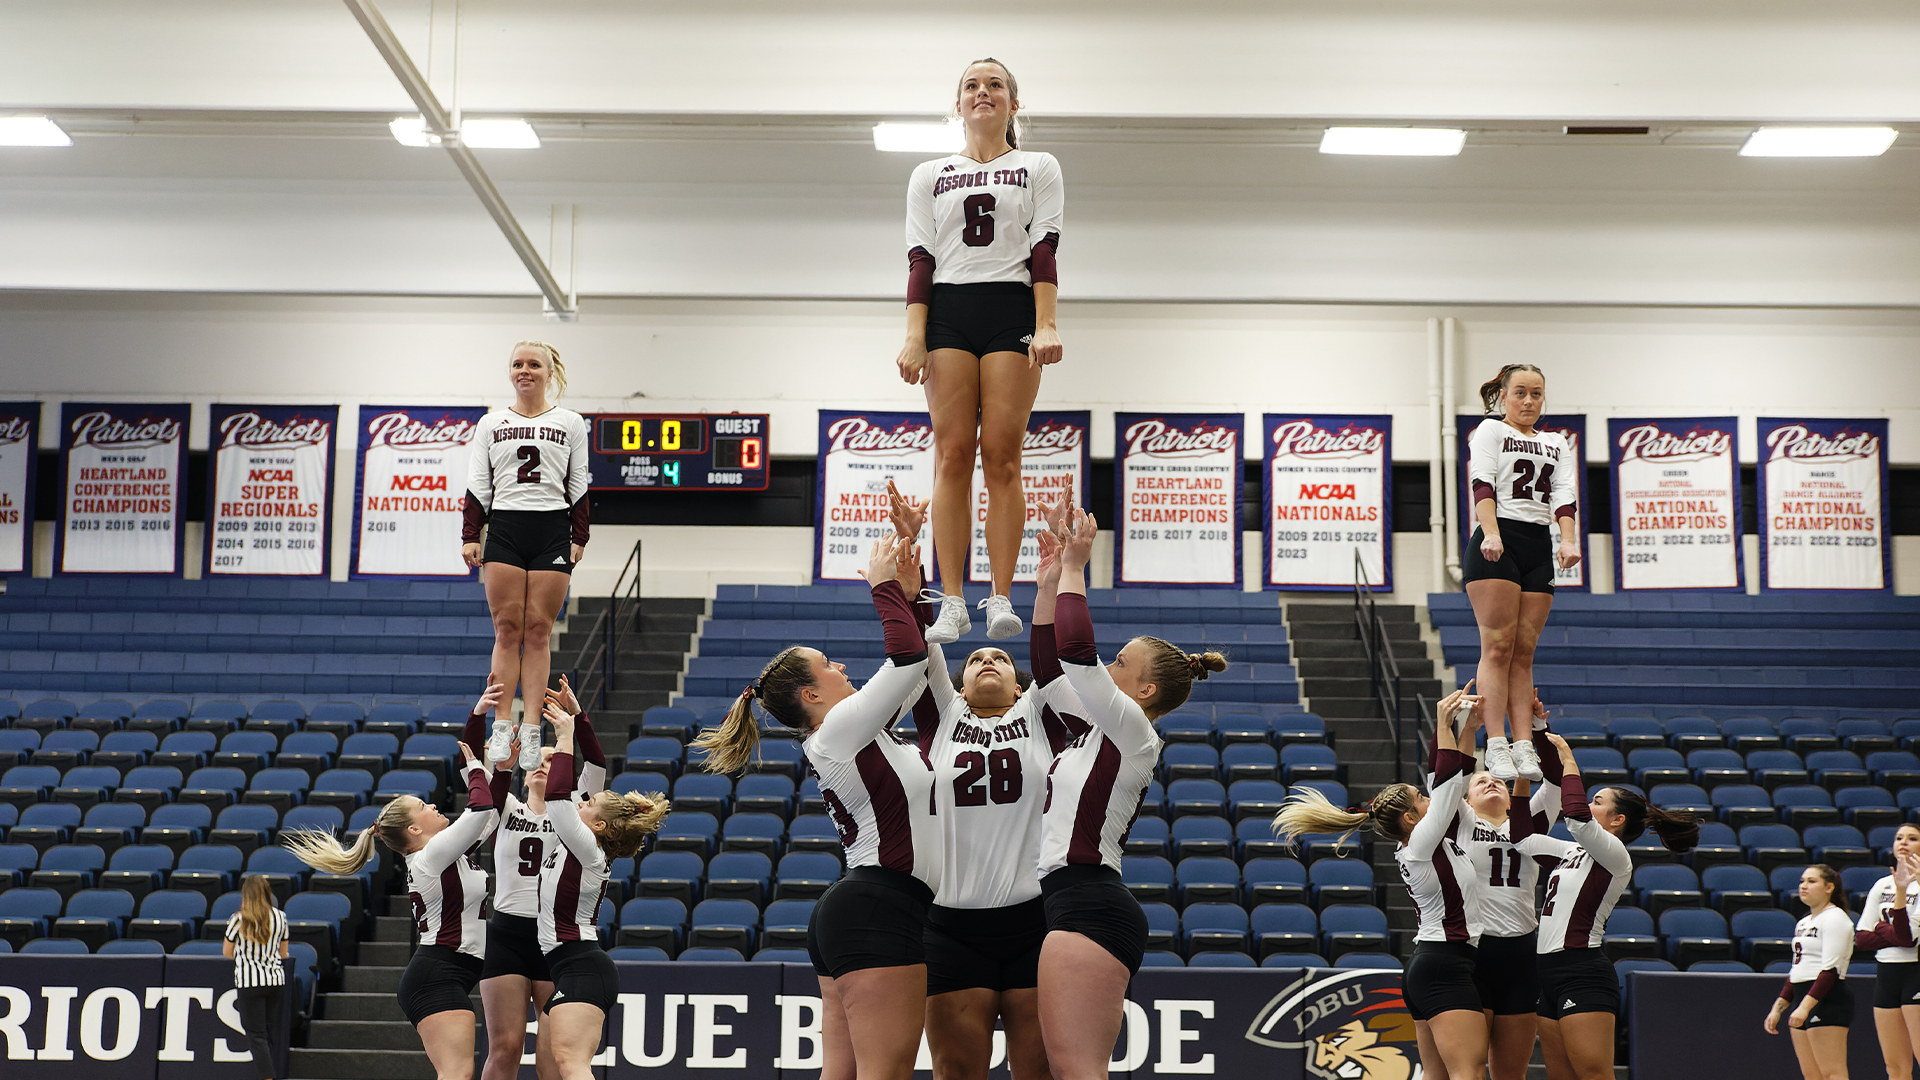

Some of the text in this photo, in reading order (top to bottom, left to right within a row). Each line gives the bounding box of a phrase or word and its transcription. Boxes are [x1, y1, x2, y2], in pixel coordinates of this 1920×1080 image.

[962, 193, 996, 247] 6
[71, 411, 181, 448] Patriots
[219, 411, 329, 448] Patriots
[368, 412, 477, 448] Patriots
[715, 418, 760, 434] GUEST
[493, 427, 566, 446] MISSOURI STATE
[827, 417, 935, 453] Patriots
[1125, 420, 1236, 456] Patriots
[1273, 420, 1384, 457] Patriots
[1619, 425, 1730, 461] Patriots
[1766, 424, 1879, 461] Patriots
[741, 438, 761, 469] 0
[1502, 436, 1543, 456] MISSOURI
[517, 445, 541, 484] 2
[630, 456, 650, 465] POSS
[80, 468, 167, 480] HEARTLAND
[248, 469, 293, 482] NCAA
[621, 465, 659, 477] PERIOD
[663, 461, 679, 485] 4
[707, 473, 743, 485] BONUS
[1512, 458, 1555, 504] 24
[74, 483, 171, 496] CONFERENCE
[390, 475, 447, 491] NCAA
[1136, 477, 1223, 489] HEARTLAND
[241, 485, 298, 500] SUPER
[840, 493, 920, 507] NATIOAL
[1131, 492, 1227, 505] CONFERENCE
[1298, 484, 1355, 500] NCAA
[72, 498, 171, 514] CHAMPIONS
[221, 502, 318, 518] REGIONALS
[367, 496, 465, 512] NATIONALS
[1635, 501, 1718, 514] NATIONAL
[1783, 502, 1866, 515] NATIONAL
[831, 508, 928, 523] CHAMPS
[1130, 508, 1228, 523] CHAMPIONS
[1277, 505, 1377, 521] NATIONALS
[71, 520, 170, 530] 2013 2015 2016
[217, 521, 316, 532] 2009 2010 2013
[367, 521, 396, 532] 2016
[1627, 515, 1728, 531] CHAMPIONS
[1774, 516, 1874, 531] CHAMPIONS
[829, 526, 860, 537] 2009
[1129, 529, 1228, 541] 2016 2017 2018
[1277, 531, 1378, 542] 2009 2015 2022
[217, 538, 315, 549] 2014 2015 2016
[1626, 534, 1731, 546] 2021 2022 2023
[1773, 536, 1877, 547] 2021 2022 2023
[829, 544, 857, 554] 2018
[1277, 548, 1307, 559] 2023
[215, 556, 243, 566] 2017
[1627, 553, 1658, 563] 2024
[994, 716, 1030, 743] STATE
[953, 747, 1023, 807] 28
[518, 837, 543, 876] 9
[1489, 847, 1521, 887] 11
[1293, 983, 1364, 1035] DBU
